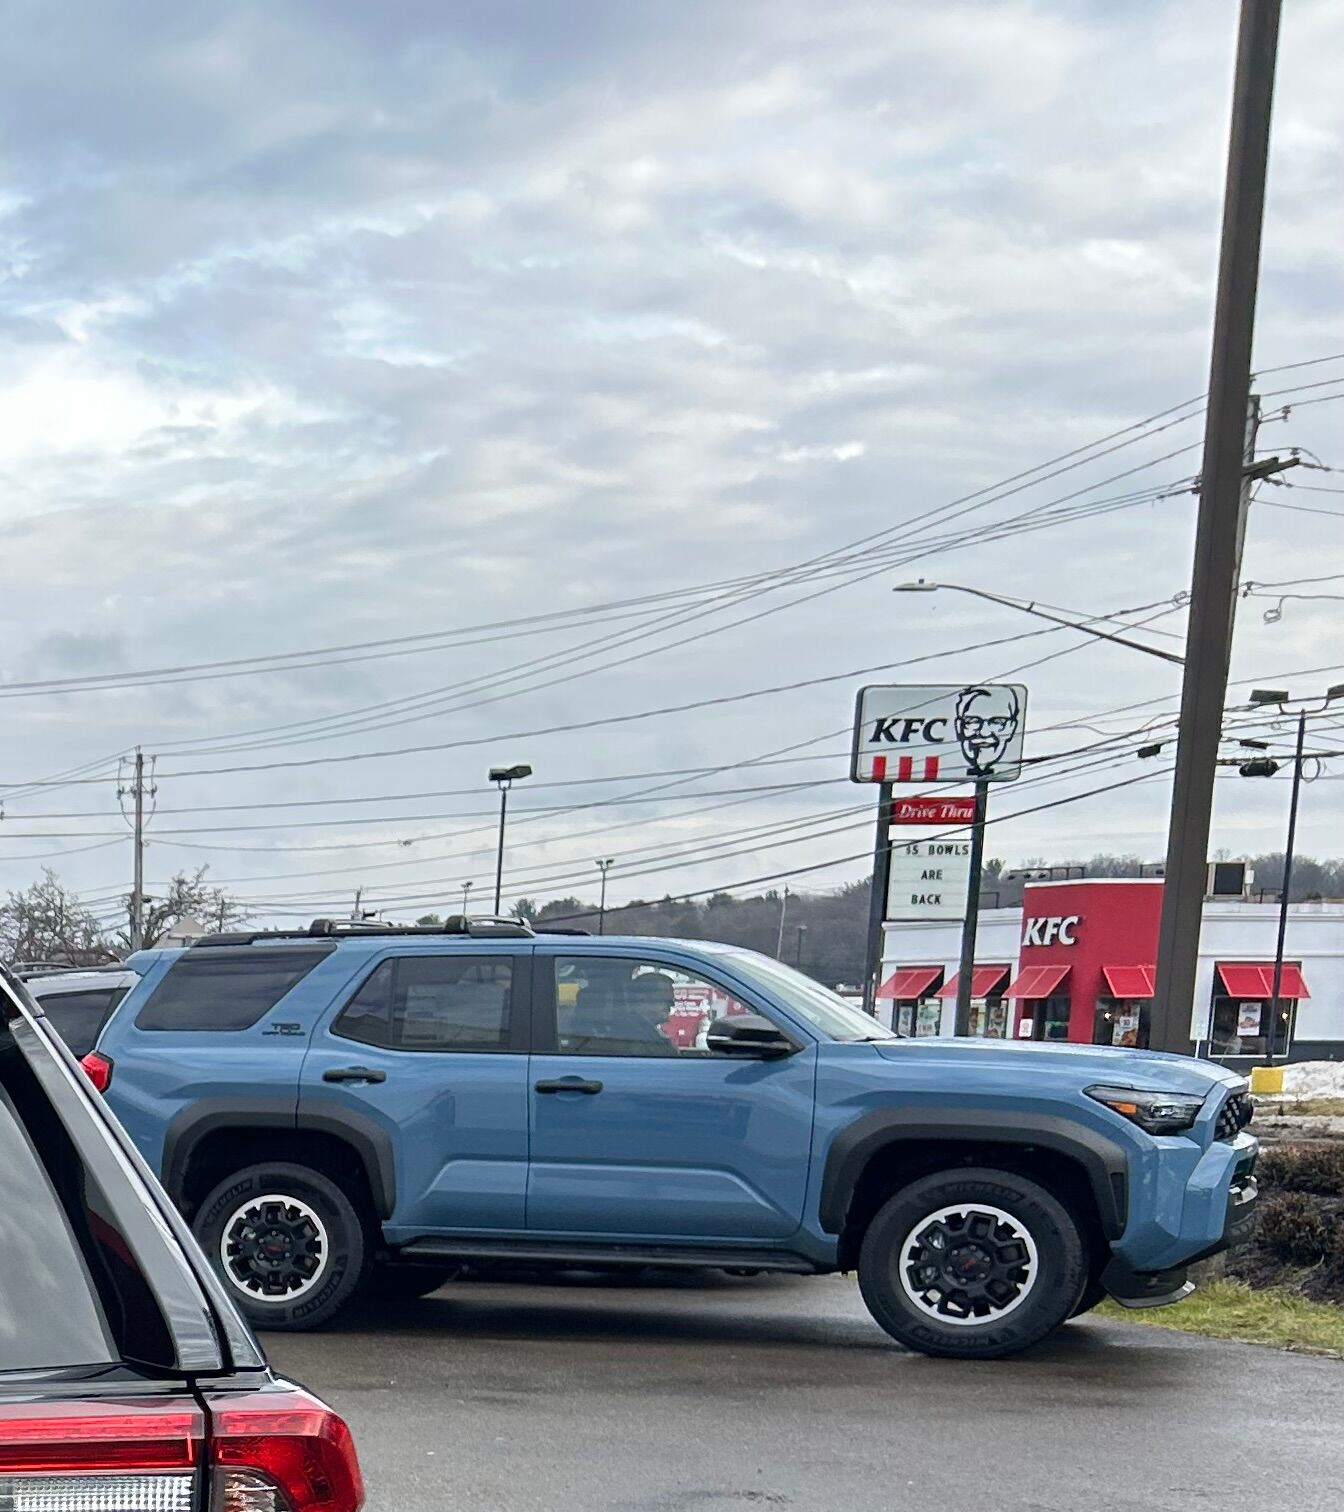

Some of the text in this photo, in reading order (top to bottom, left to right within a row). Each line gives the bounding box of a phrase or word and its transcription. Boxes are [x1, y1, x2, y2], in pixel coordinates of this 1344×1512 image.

[869, 718, 947, 743] KFC
[899, 804, 974, 819] Drive Thru
[928, 844, 969, 856] BOWLS
[921, 869, 943, 881] ARE
[911, 894, 942, 905] BACK
[1022, 916, 1079, 946] KFC
